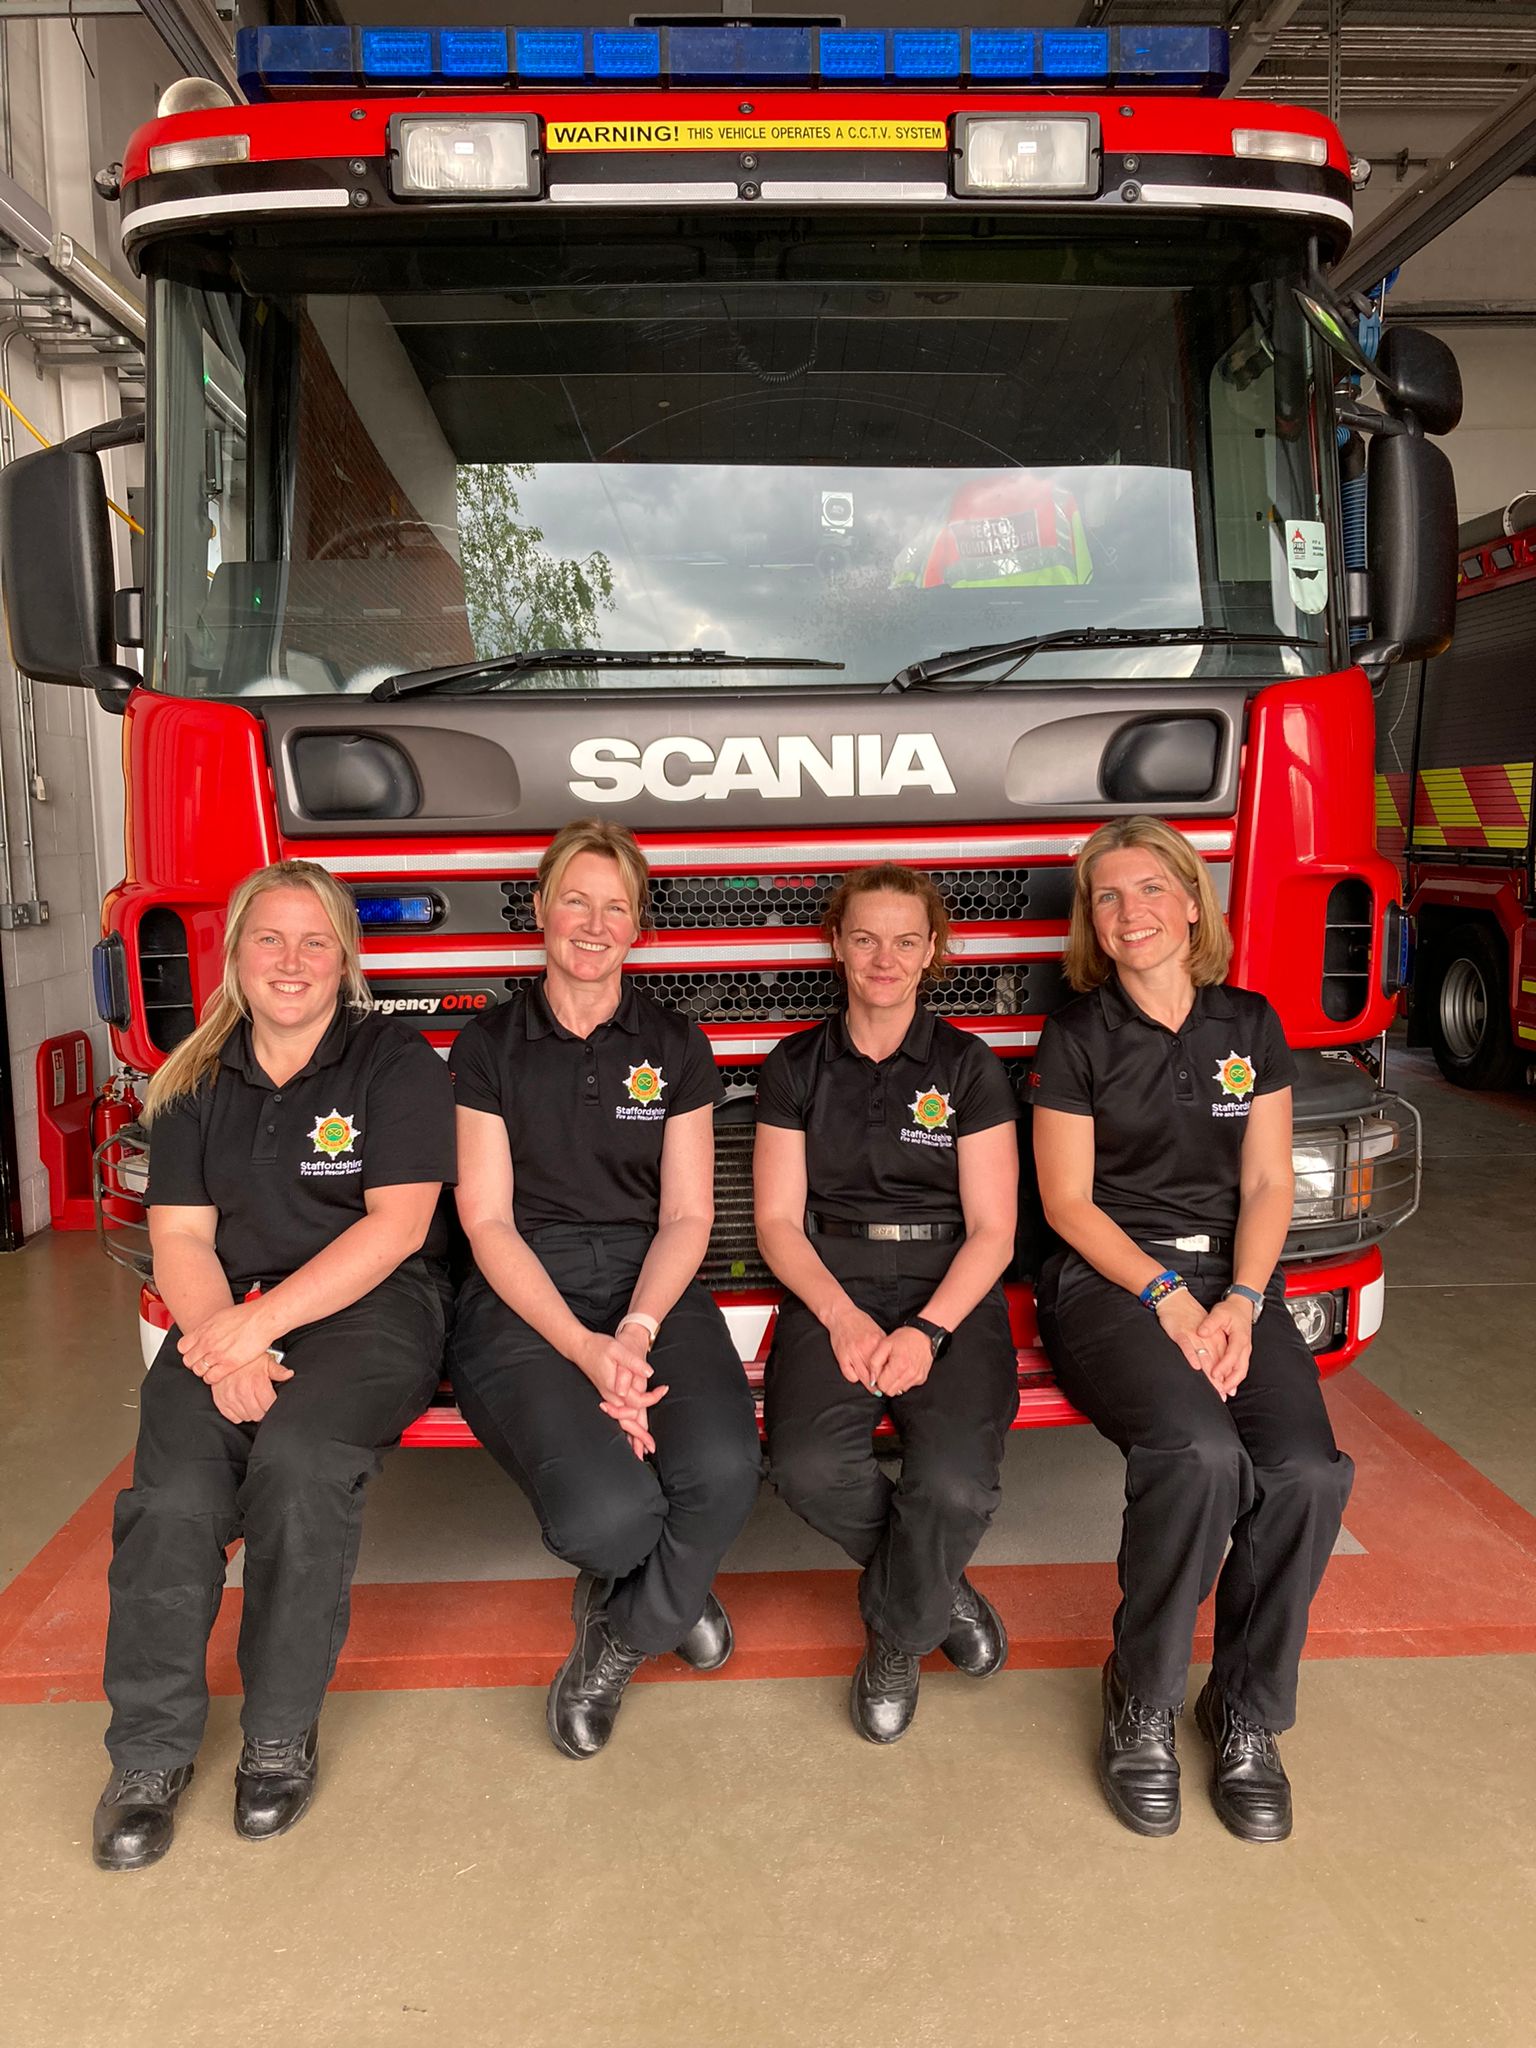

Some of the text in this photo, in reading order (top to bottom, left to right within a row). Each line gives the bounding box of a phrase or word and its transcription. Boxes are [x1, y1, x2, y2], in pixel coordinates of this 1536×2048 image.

[554, 126, 942, 143] WARNING! THIS VEHICLE OPERATES A C.C.T.V. SYSTEM
[568, 733, 958, 802] SCANIA
[442, 993, 488, 1010] one
